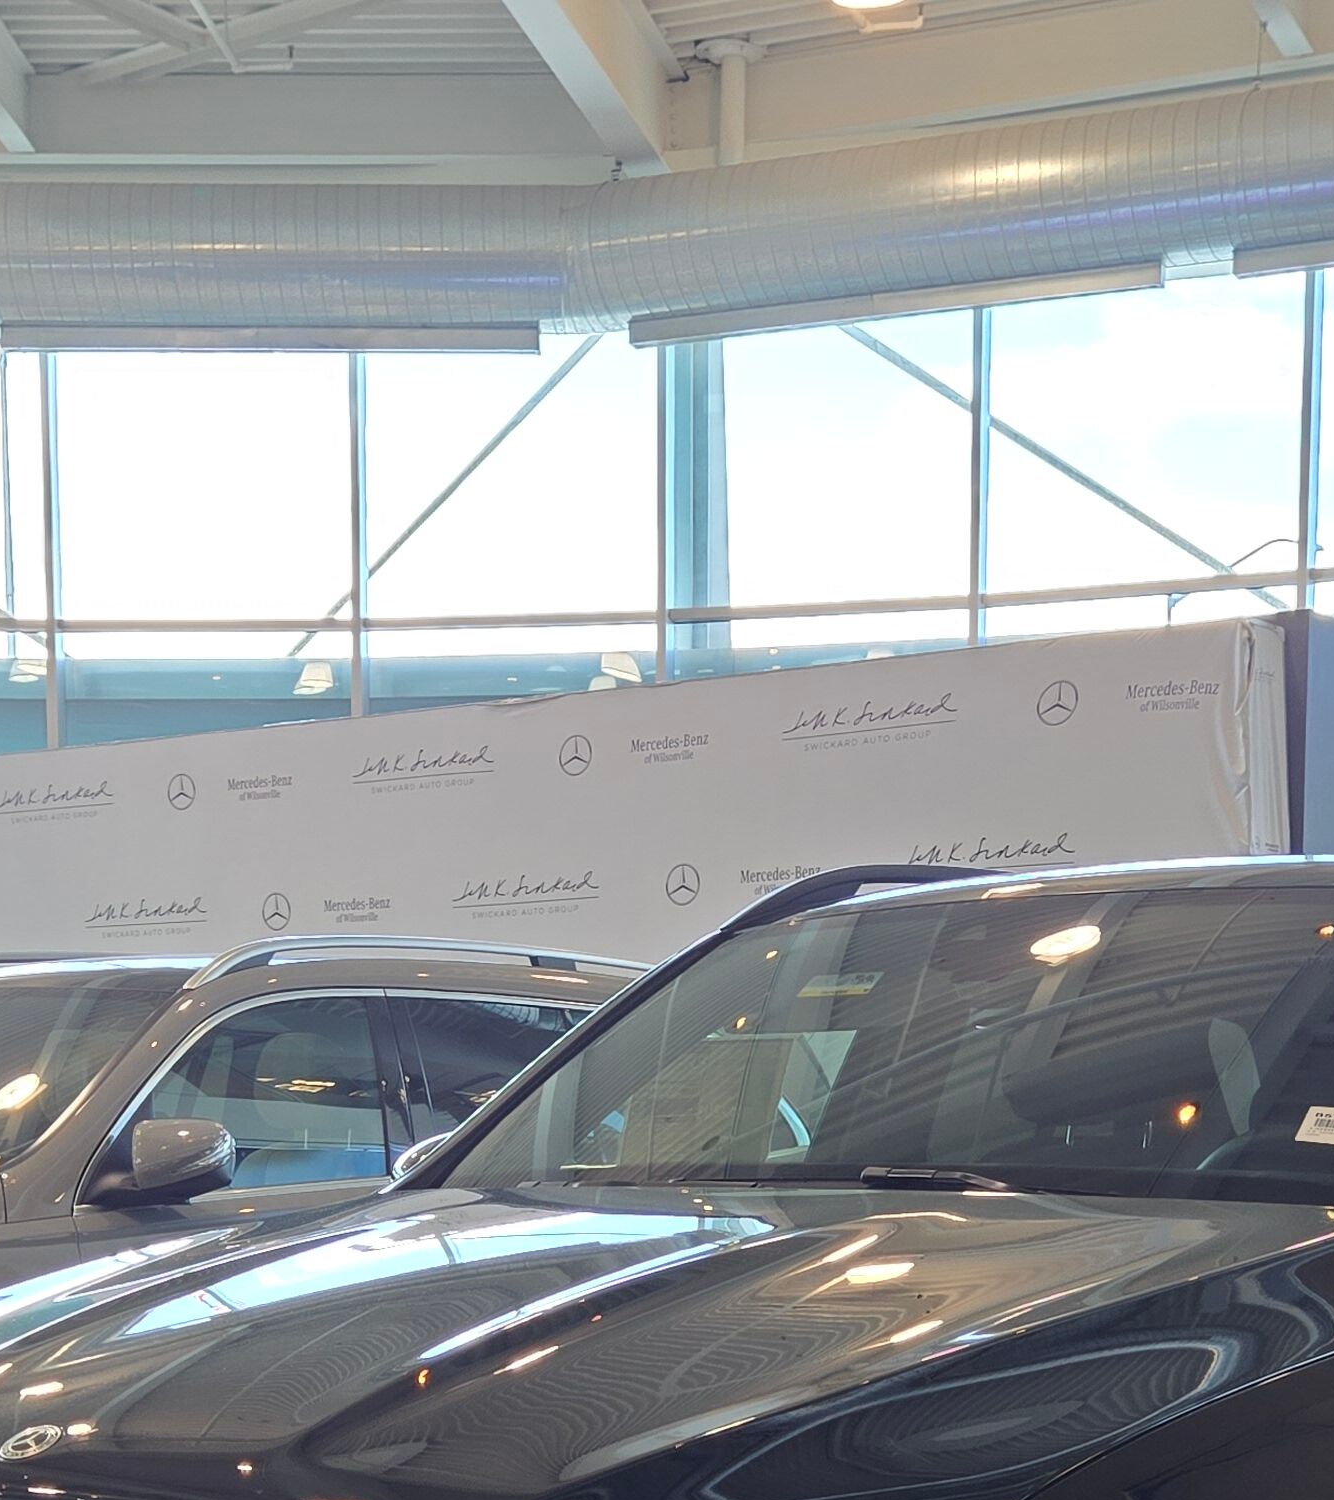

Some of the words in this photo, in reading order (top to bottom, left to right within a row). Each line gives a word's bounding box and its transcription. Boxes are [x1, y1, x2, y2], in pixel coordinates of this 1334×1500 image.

[1125, 680, 1220, 700] Mercedes-Benz
[1139, 700, 1149, 713] of
[1150, 697, 1201, 711] Wilsonville
[630, 733, 710, 753] Mercedes-Benz
[804, 739, 857, 752] SWICKARD
[862, 734, 891, 745] AUTO
[894, 729, 931, 741] GROUP
[227, 775, 293, 791] Mercedes-Benz
[371, 783, 416, 795] SWICKARD
[419, 781, 443, 791] AUTO
[445, 778, 475, 788] GROUP
[323, 897, 391, 913] Mercedes-Benz
[472, 909, 518, 920] SWICKARD
[521, 907, 544, 916] AUTO
[548, 905, 579, 914] GROUP
